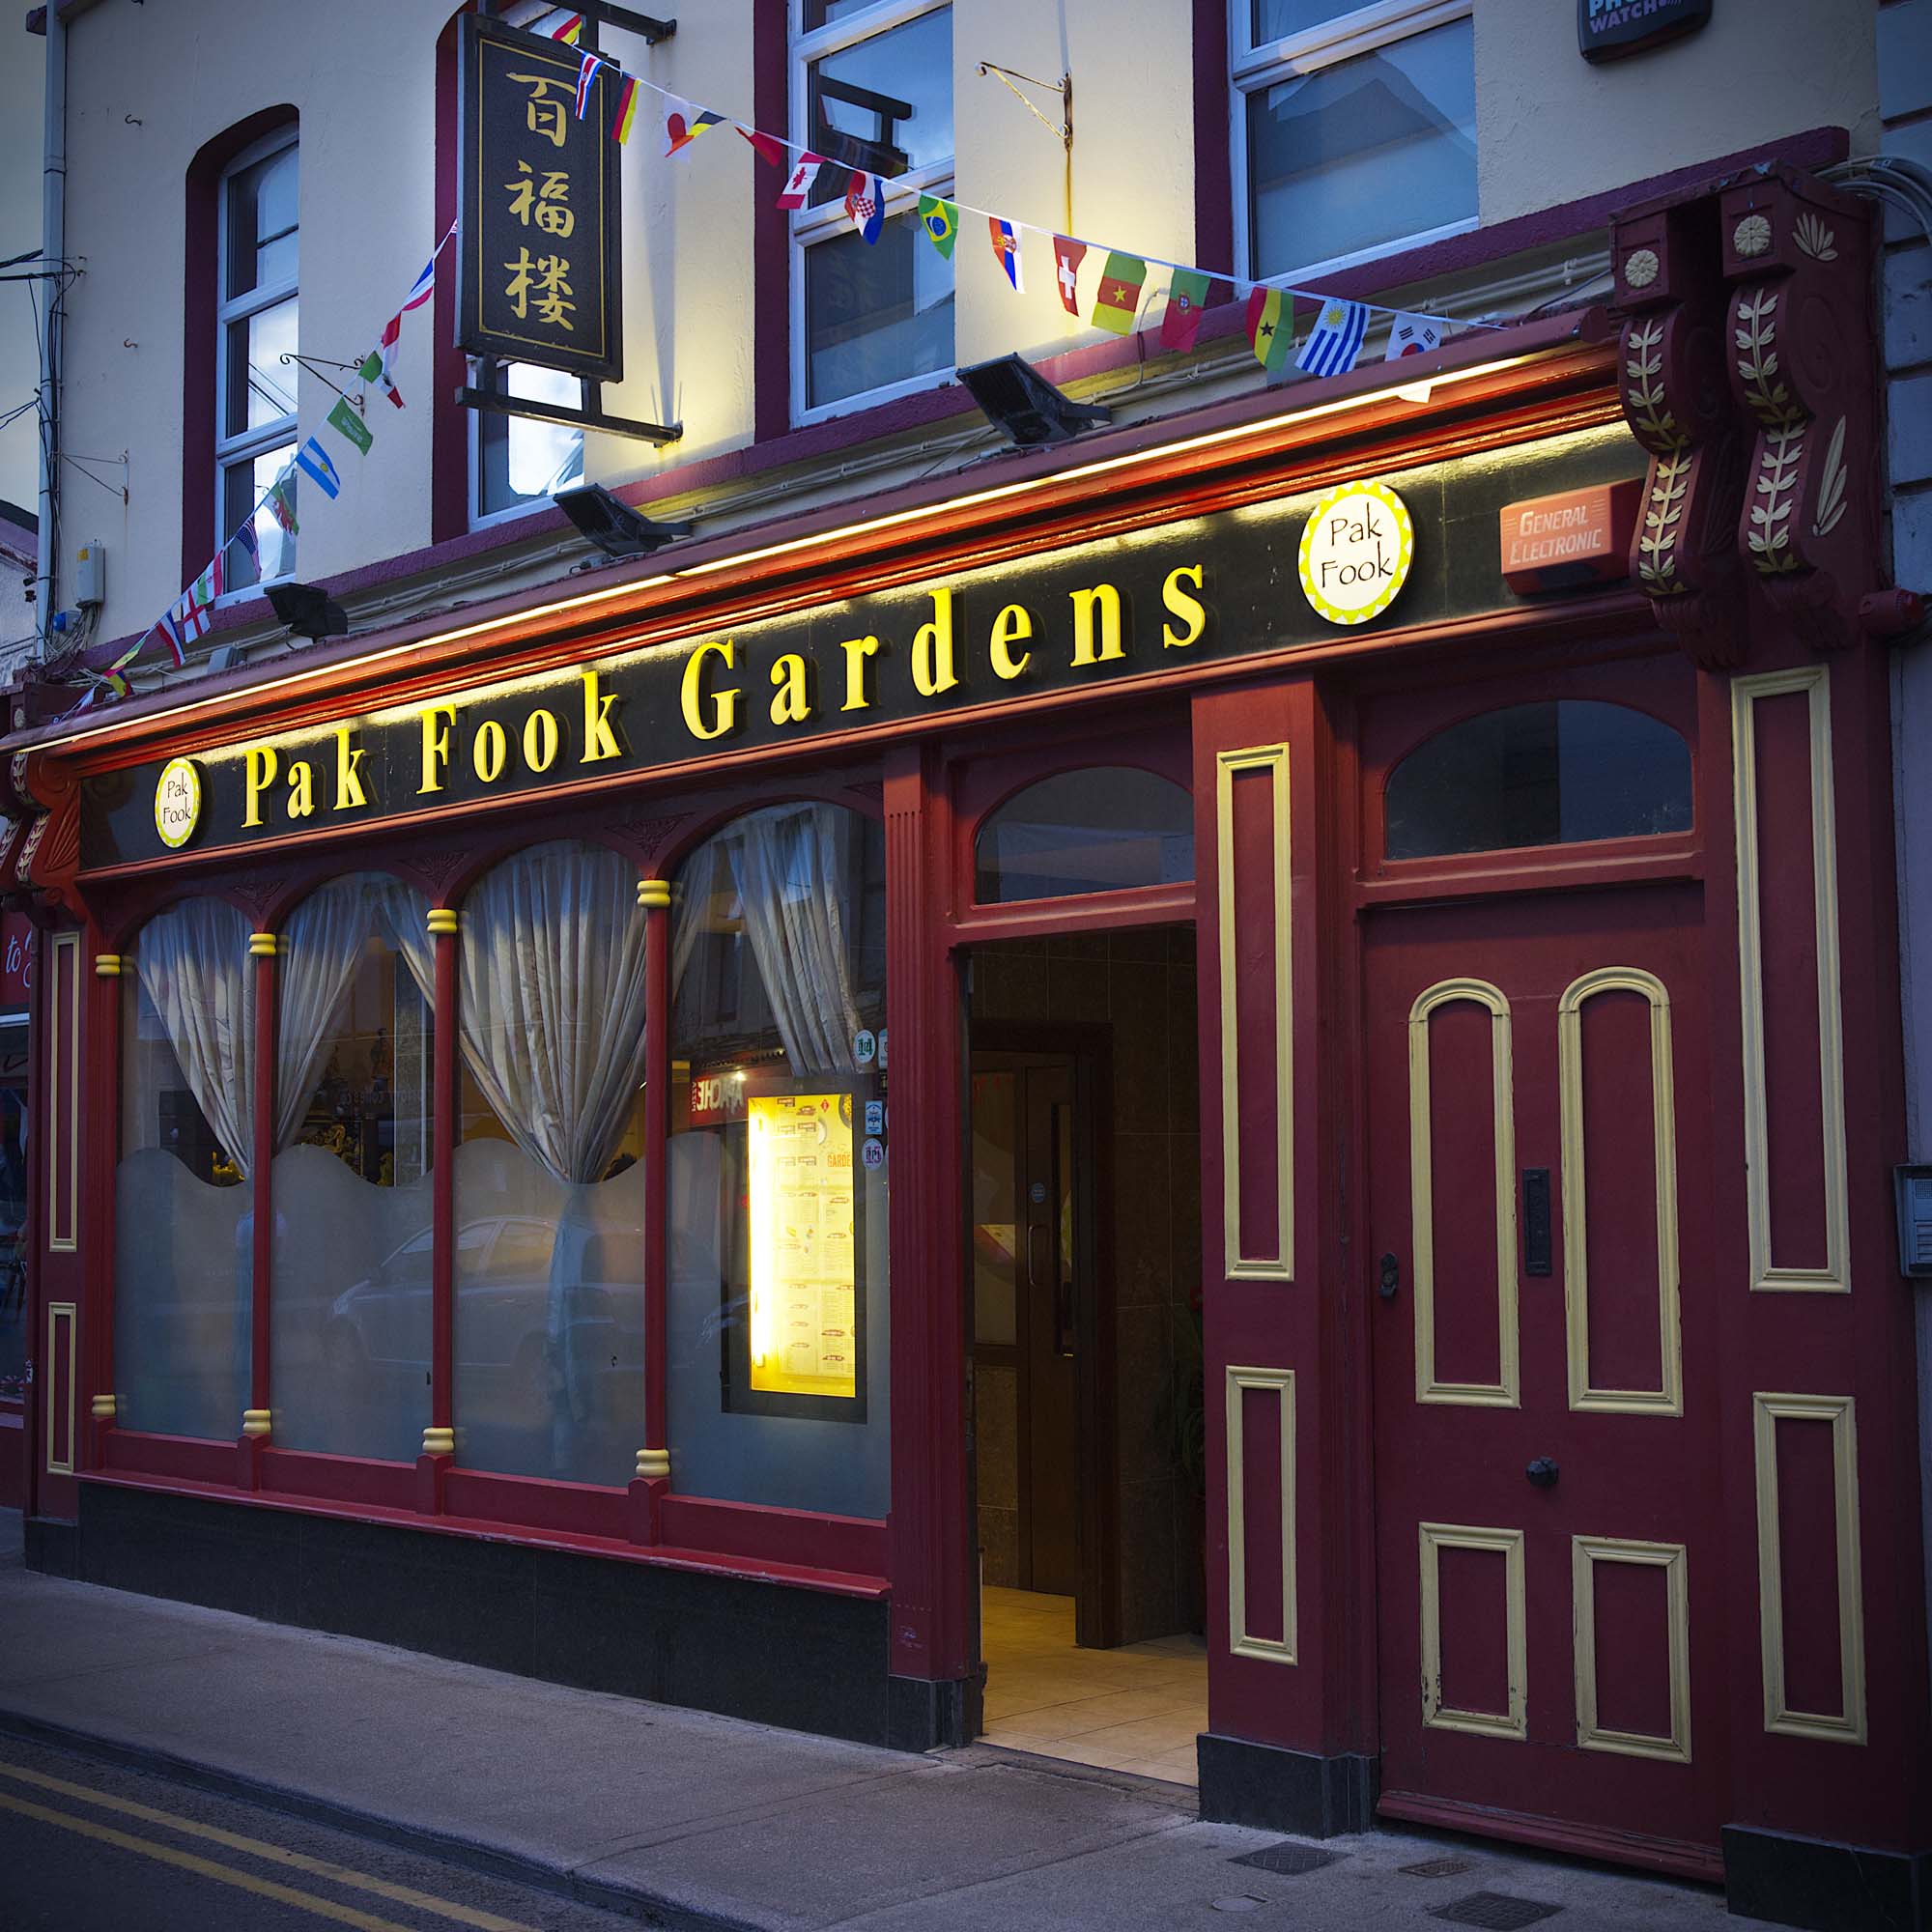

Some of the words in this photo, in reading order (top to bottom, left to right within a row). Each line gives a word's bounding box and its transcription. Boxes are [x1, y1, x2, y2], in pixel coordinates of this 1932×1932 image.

[1590, 0, 1658, 33] WATCH
[505, 71, 577, 330] 百福楼
[1330, 502, 1382, 547] Pak
[1520, 505, 1589, 536] GENERAL
[1321, 541, 1393, 588] Fook
[241, 726, 368, 829] Pak
[415, 670, 623, 795] Fook
[680, 564, 1207, 740] Gardens
[167, 773, 187, 798] Pak
[162, 797, 191, 824] Fook
